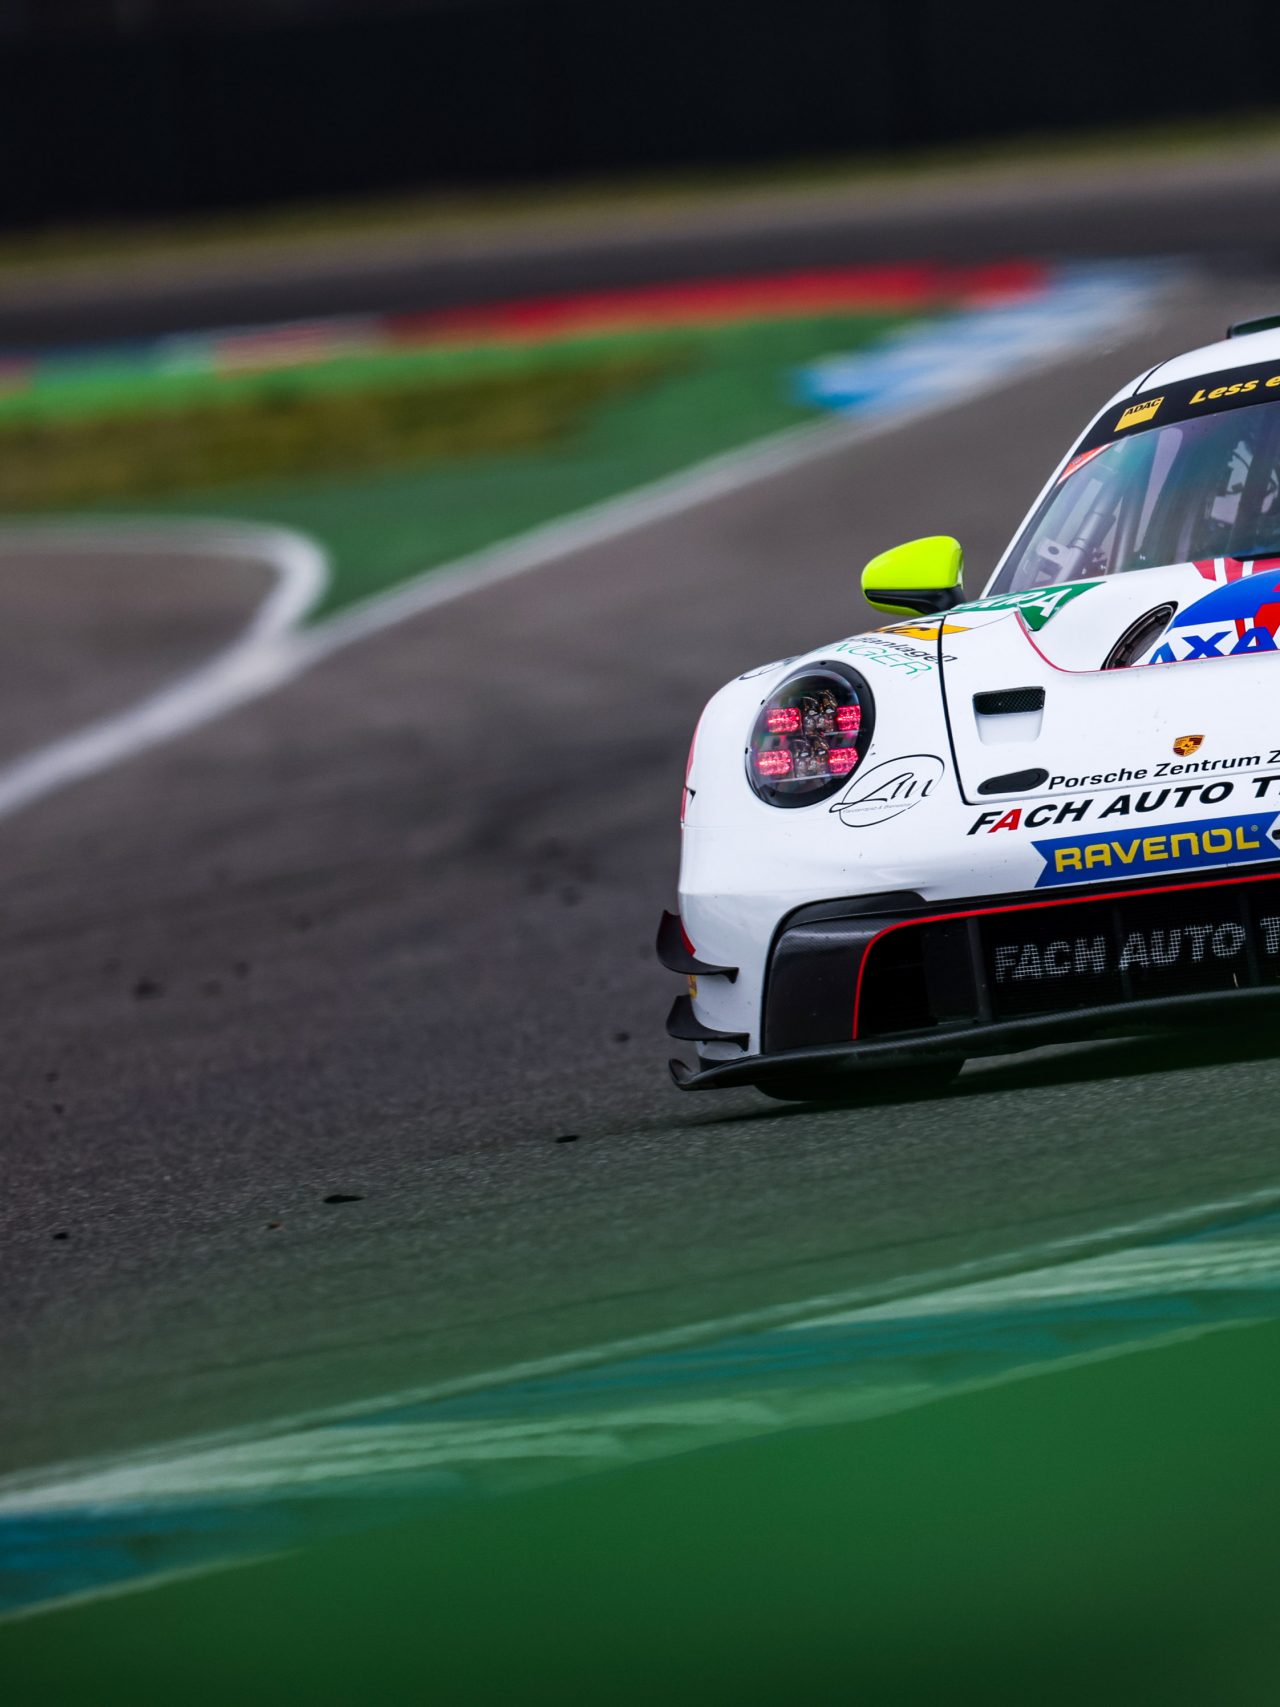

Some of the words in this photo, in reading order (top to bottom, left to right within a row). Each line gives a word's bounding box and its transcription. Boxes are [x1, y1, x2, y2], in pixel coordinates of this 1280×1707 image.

[1123, 398, 1162, 417] ADAC
[1189, 379, 1260, 405] Less
[1047, 767, 1148, 791] Porsche
[1153, 754, 1261, 779] Zentrum
[966, 799, 1094, 836] FACH
[1098, 781, 1235, 819] AUTO
[995, 935, 1106, 984] FACH
[1118, 922, 1246, 971] AUTO
